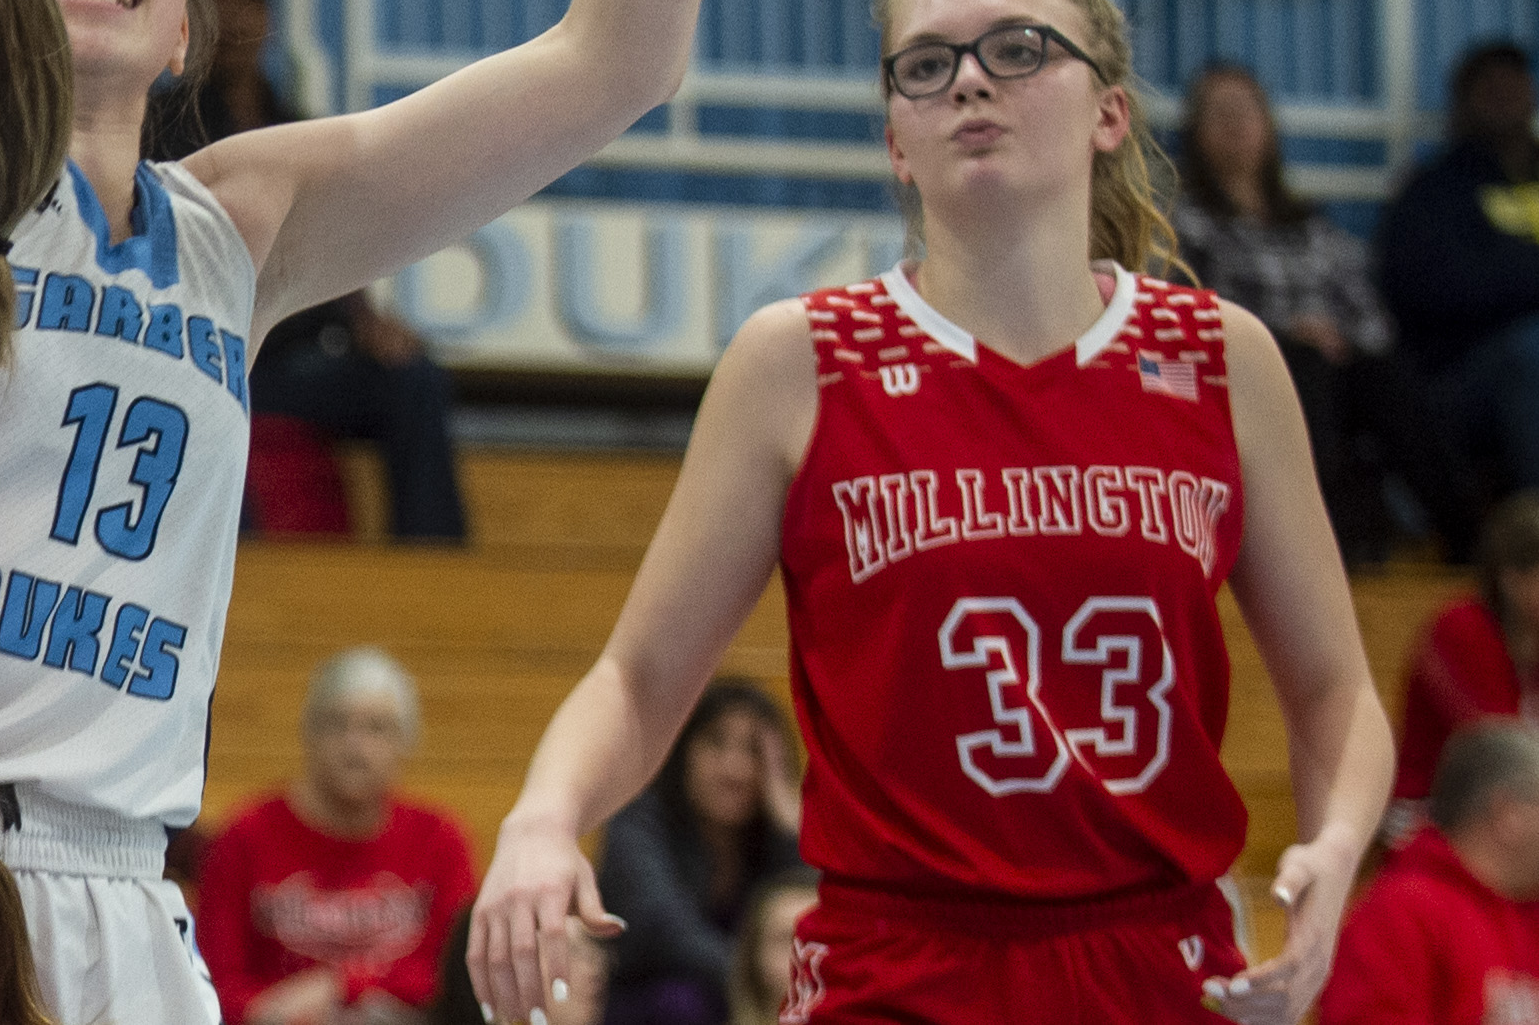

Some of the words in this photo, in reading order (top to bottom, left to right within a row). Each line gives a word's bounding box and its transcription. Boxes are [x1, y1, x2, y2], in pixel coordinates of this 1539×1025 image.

[392, 209, 904, 346] DUK
[48, 381, 189, 561] 13
[938, 597, 1175, 797] 33
